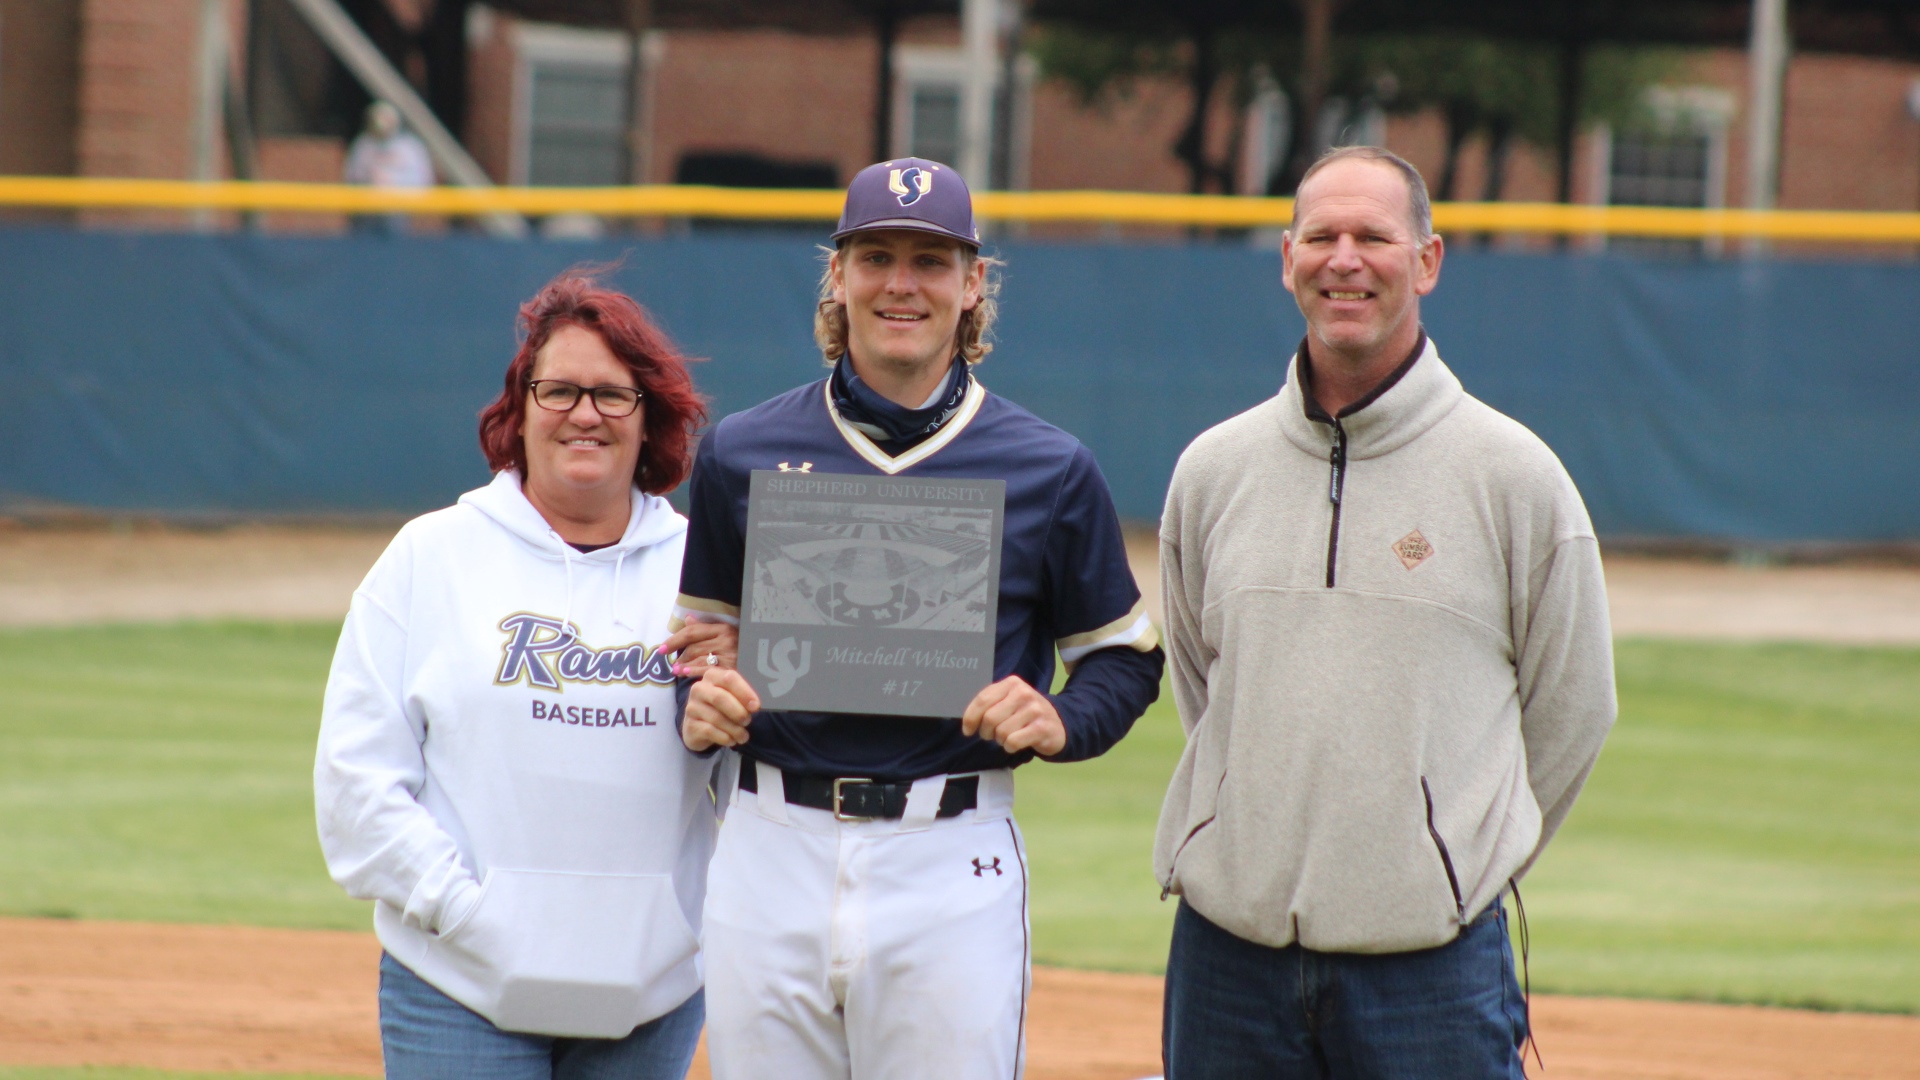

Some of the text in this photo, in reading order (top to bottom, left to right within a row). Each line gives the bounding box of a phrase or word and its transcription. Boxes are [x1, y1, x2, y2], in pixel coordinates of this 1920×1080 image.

[766, 479, 989, 502] SHEPHERD UNIVERSITY
[492, 610, 677, 694] Rams
[825, 646, 979, 670] Mitchell Wilson
[881, 679, 923, 697] #17
[532, 699, 657, 728] BASEBALL
